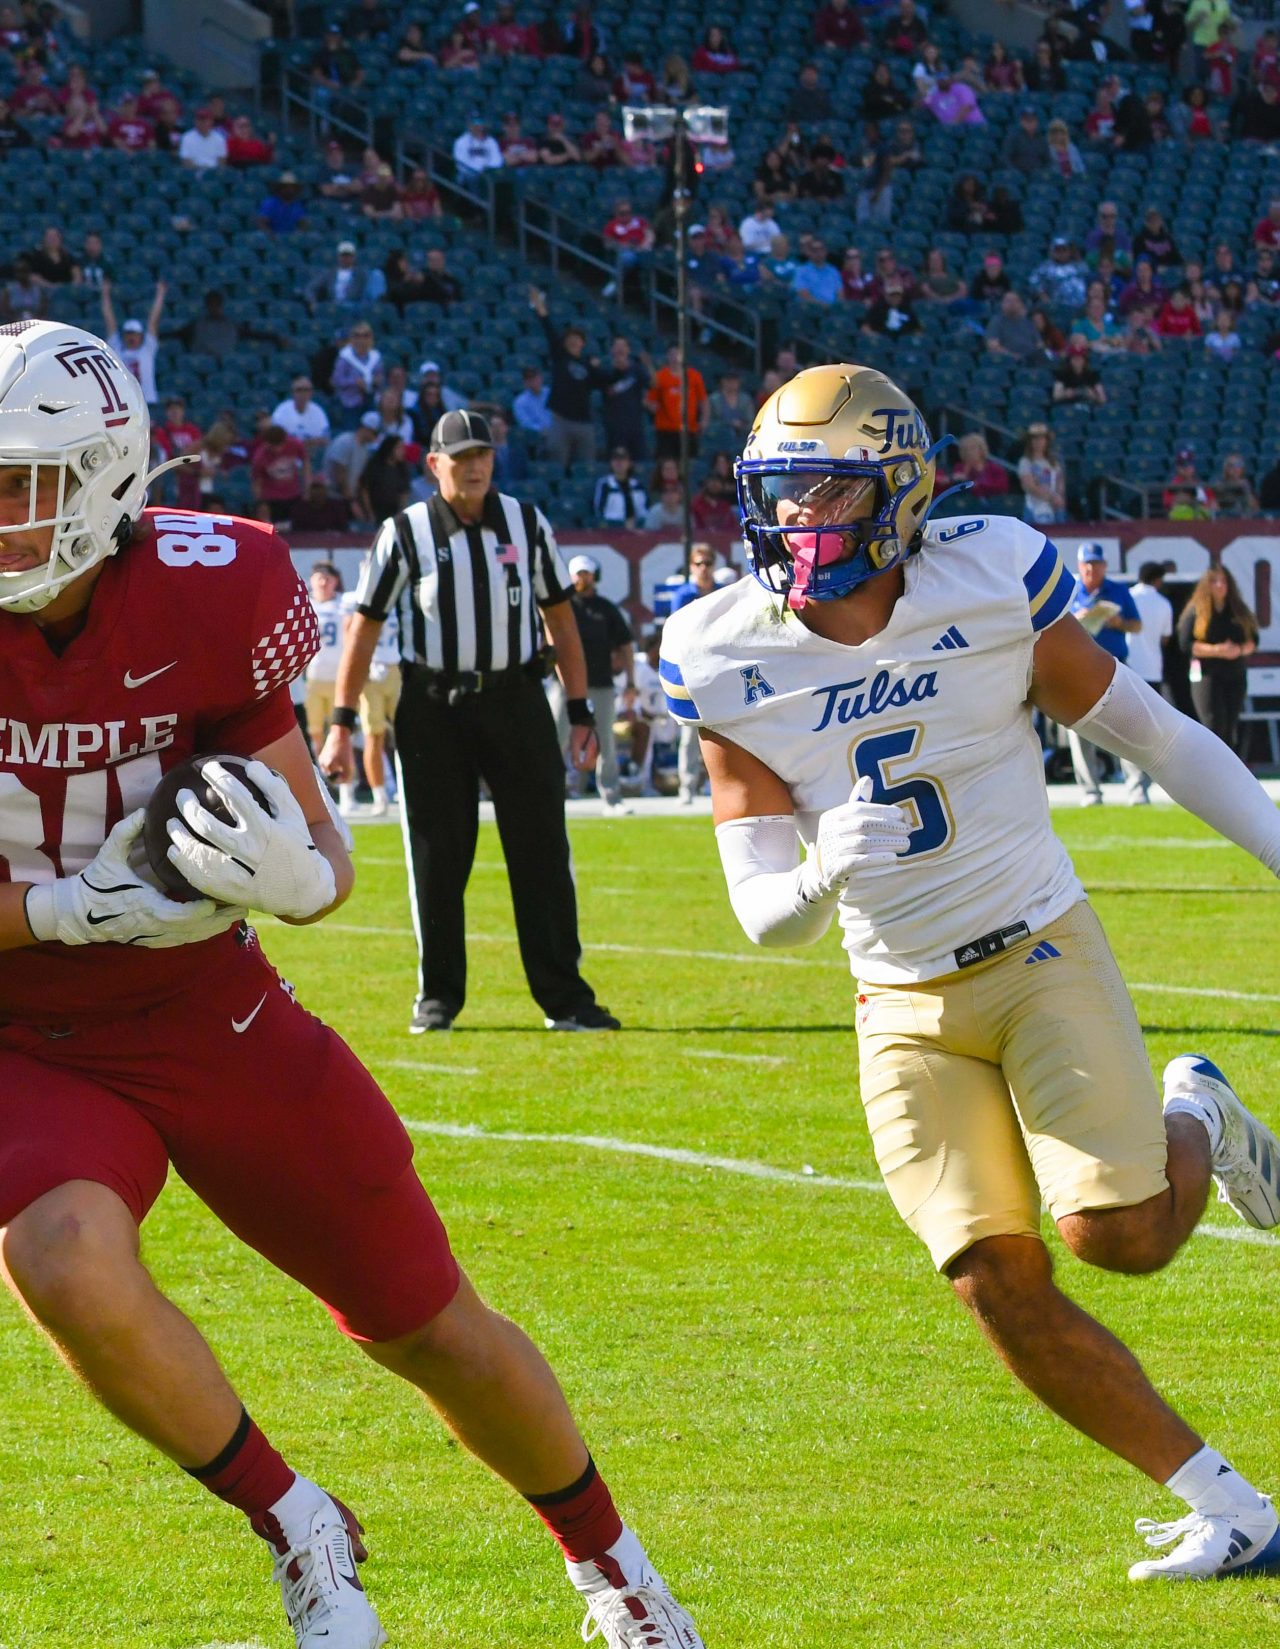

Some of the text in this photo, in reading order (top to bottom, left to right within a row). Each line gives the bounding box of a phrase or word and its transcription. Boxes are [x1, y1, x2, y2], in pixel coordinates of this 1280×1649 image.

[776, 441, 819, 452] TULSA
[437, 547, 450, 562] S
[509, 585, 522, 607] U
[811, 669, 939, 732] Tulsa
